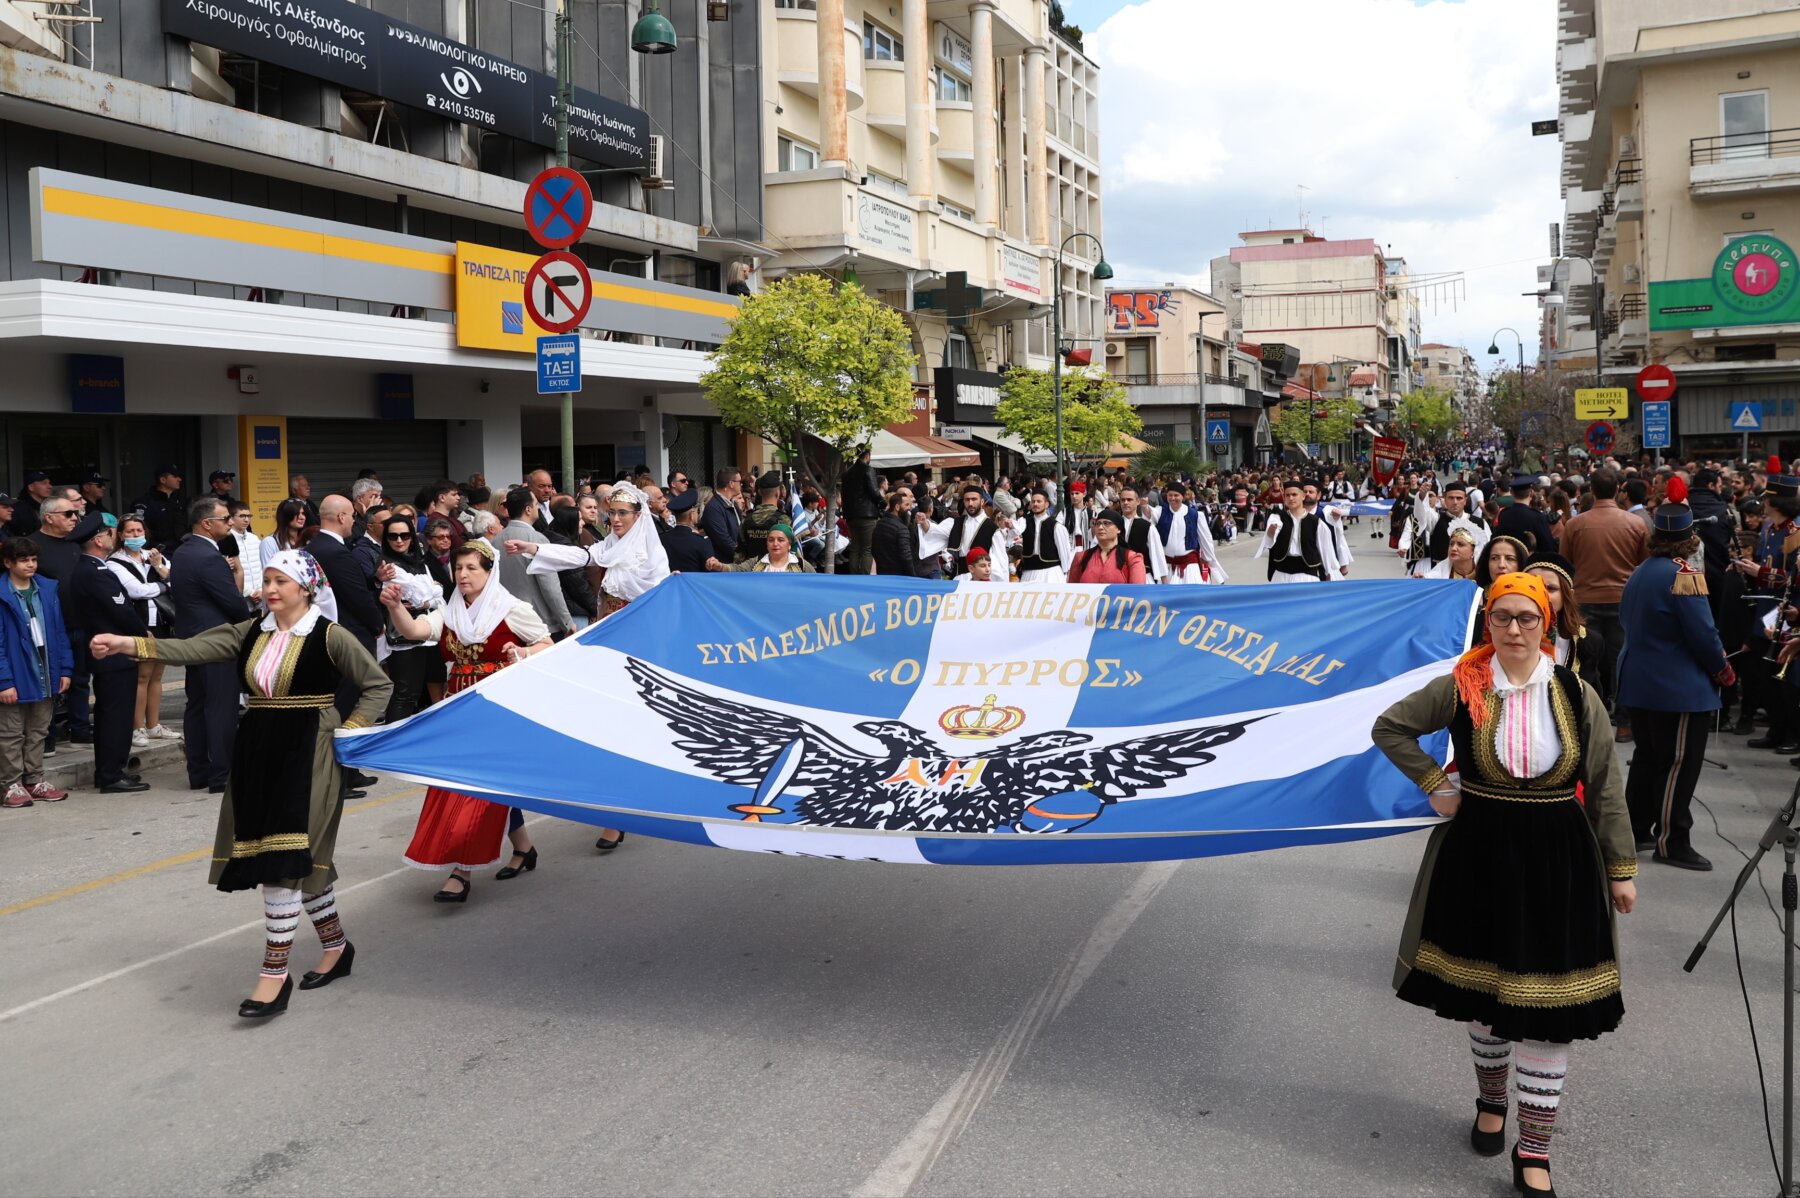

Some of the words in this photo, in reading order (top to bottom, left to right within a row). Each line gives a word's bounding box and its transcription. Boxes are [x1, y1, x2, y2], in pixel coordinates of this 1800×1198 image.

[185, 0, 271, 39] Χειρουργός
[275, 24, 367, 70] Οφθαλμίατρος
[285, 2, 366, 45] Αλέξανδρος
[488, 60, 527, 84] ΙΑΤΡΕΙΟ
[439, 98, 462, 115] 2410
[464, 103, 496, 125] 535766
[603, 114, 636, 139] Ιωάννης
[590, 129, 643, 158] Οφθαλμίατρος
[463, 261, 511, 282] ΤΡΑΠΕΖΑ
[513, 269, 529, 285] ΠΕ
[543, 360, 574, 375] ΤΑΞΙ
[79, 377, 120, 389] e-branch
[549, 379, 570, 387] ΕΚΤΟΣ
[257, 438, 278, 446] e-branch
[697, 602, 876, 665] ΣΥΝΔΕΣΜΟΣ
[885, 590, 1180, 638] ΒΟΡΕΙΟΗΠΕΙΡΩΤΩΝ
[868, 658, 921, 686] «Ο
[932, 658, 1143, 688] ΠΥΡΡΟΣ»
